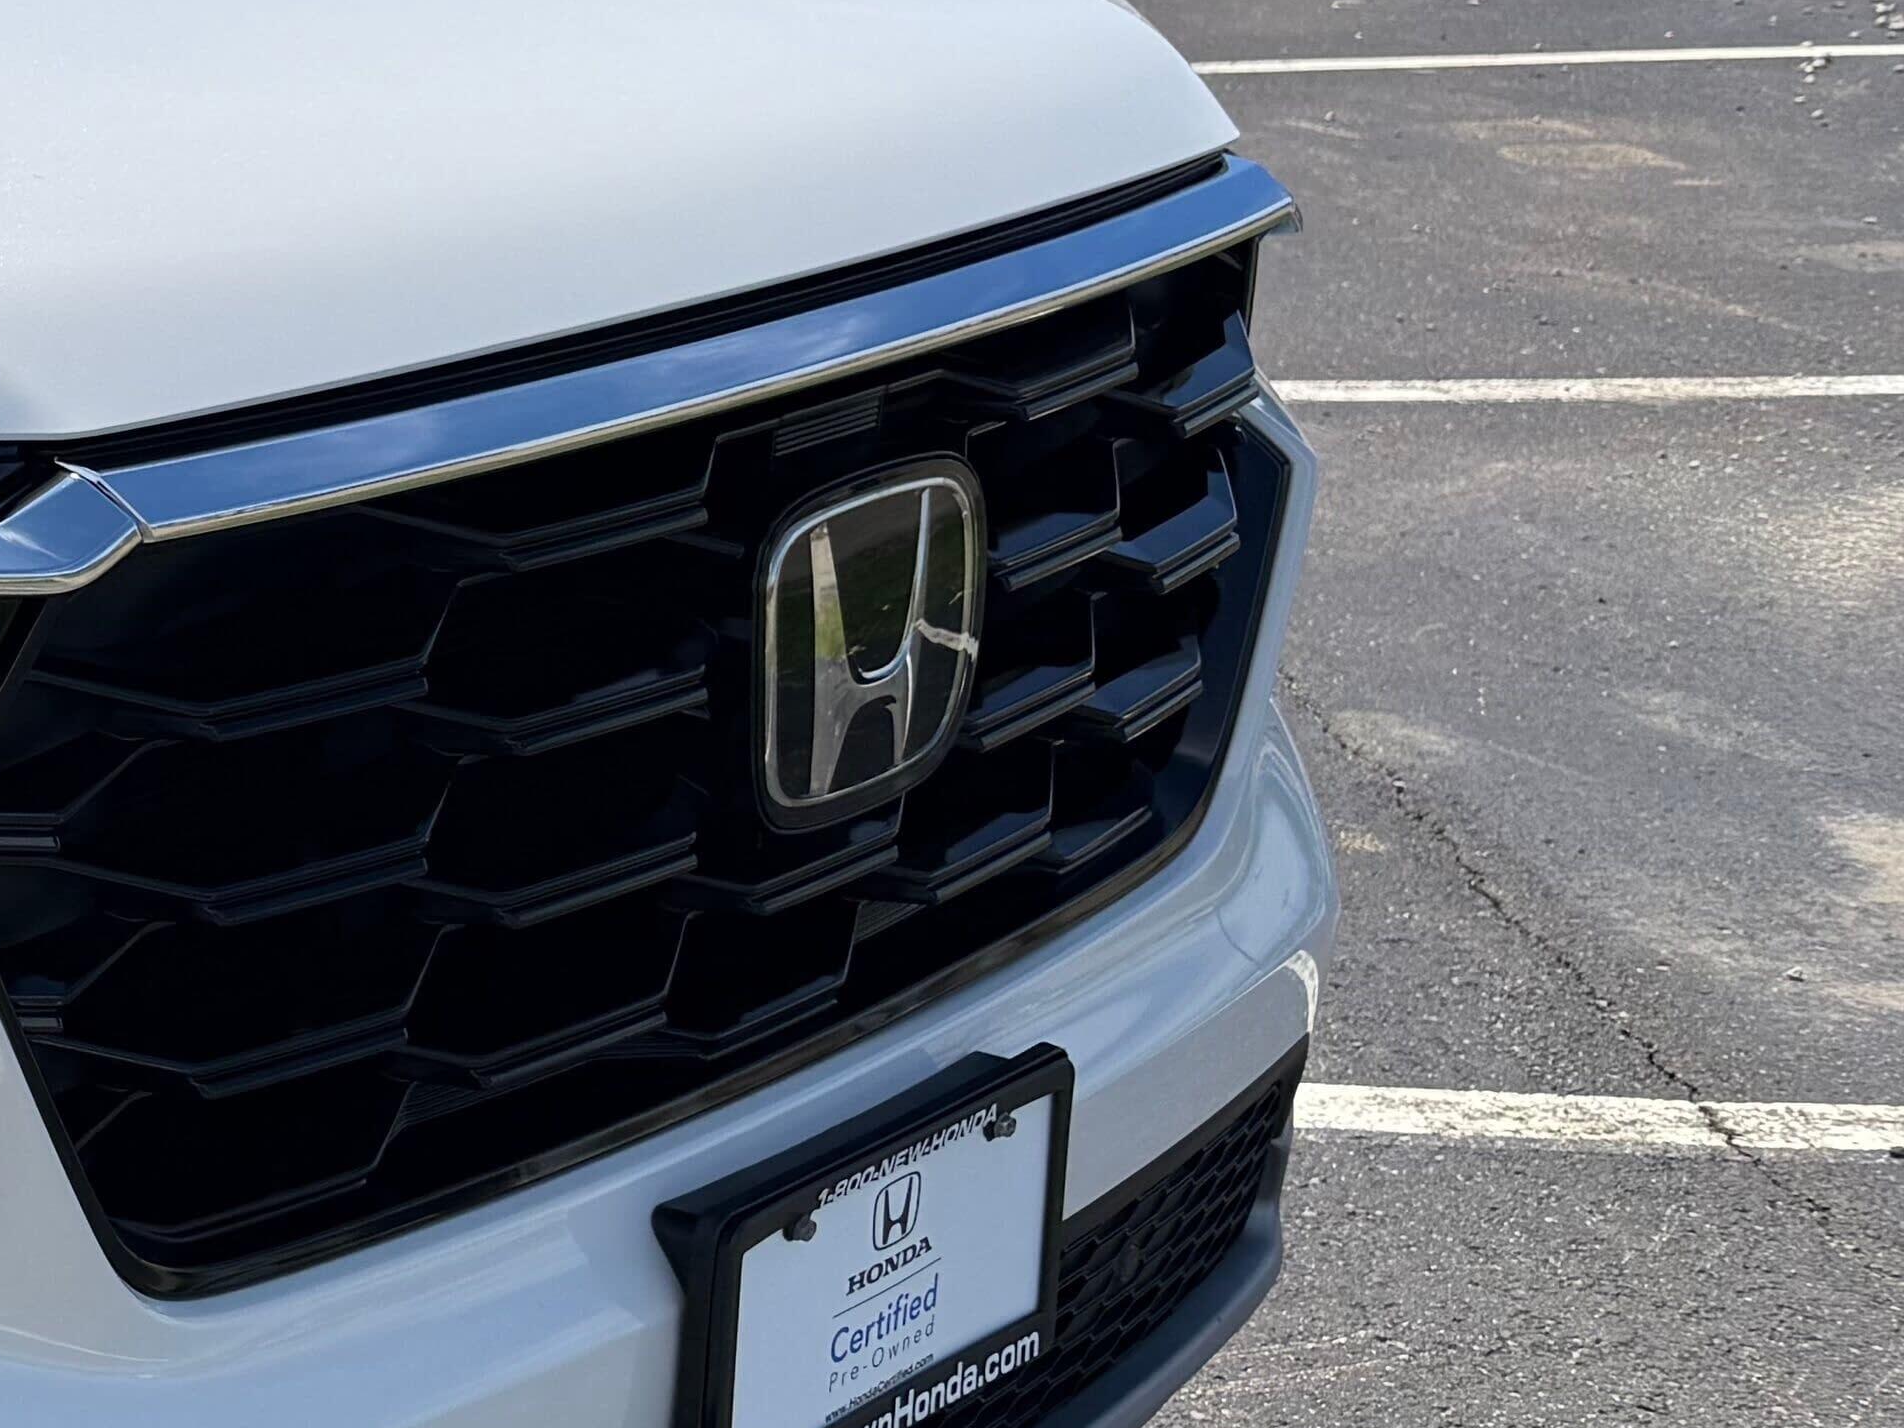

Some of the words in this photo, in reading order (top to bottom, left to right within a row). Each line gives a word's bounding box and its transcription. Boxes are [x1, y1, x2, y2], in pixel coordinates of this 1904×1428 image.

[846, 1235, 933, 1297] HONDA
[828, 1314, 935, 1394] Pre-Owned
[830, 1272, 939, 1364] Certified
